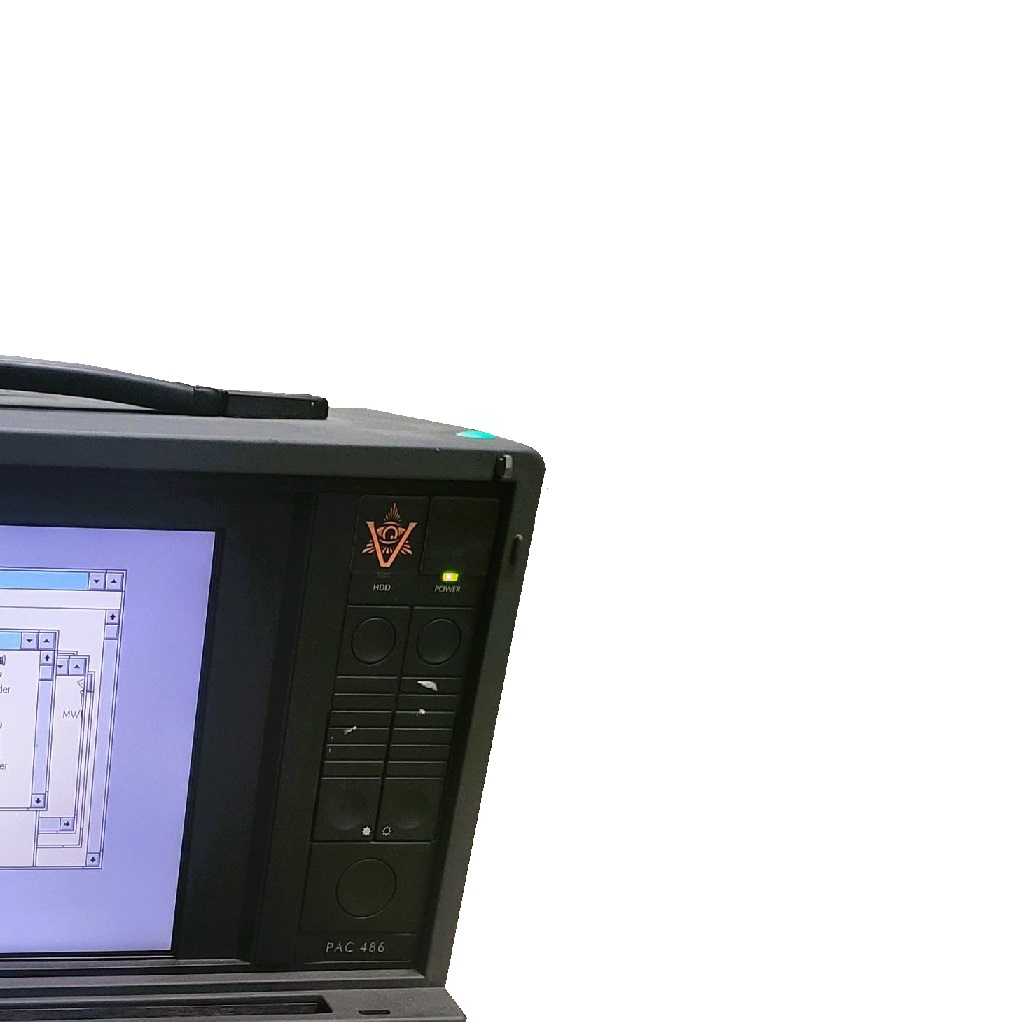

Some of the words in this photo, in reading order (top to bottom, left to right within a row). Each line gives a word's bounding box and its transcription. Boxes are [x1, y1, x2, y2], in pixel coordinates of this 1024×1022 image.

[373, 584, 391, 592] HDD
[326, 942, 354, 953] PAC
[360, 942, 385, 953] 486
